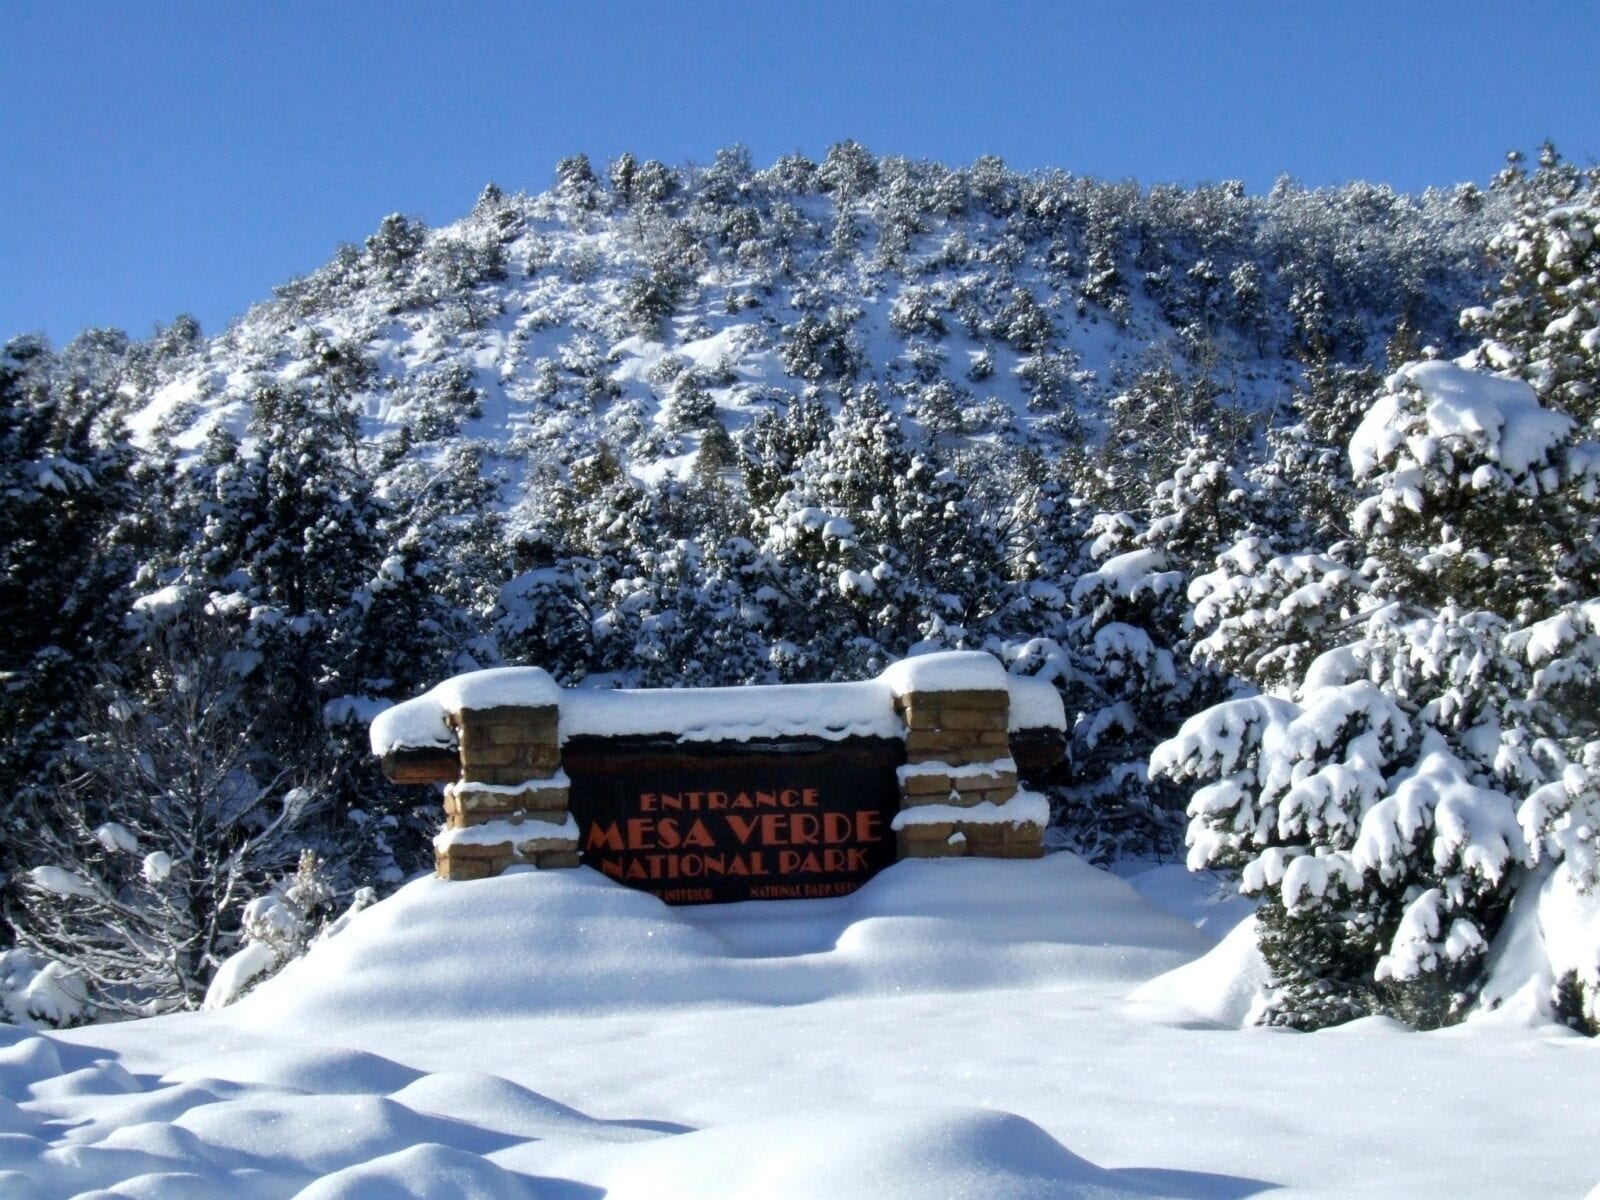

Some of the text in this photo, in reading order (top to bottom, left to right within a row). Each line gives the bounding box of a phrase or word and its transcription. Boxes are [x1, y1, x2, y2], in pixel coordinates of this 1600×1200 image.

[639, 788, 819, 811] ENTRANCE
[586, 810, 882, 851] MESA VERDE
[600, 847, 870, 880] NATIONAL PARK
[664, 887, 714, 902] INTERIOR
[750, 884, 801, 898] NATIONAL
[804, 883, 833, 896] PARK
